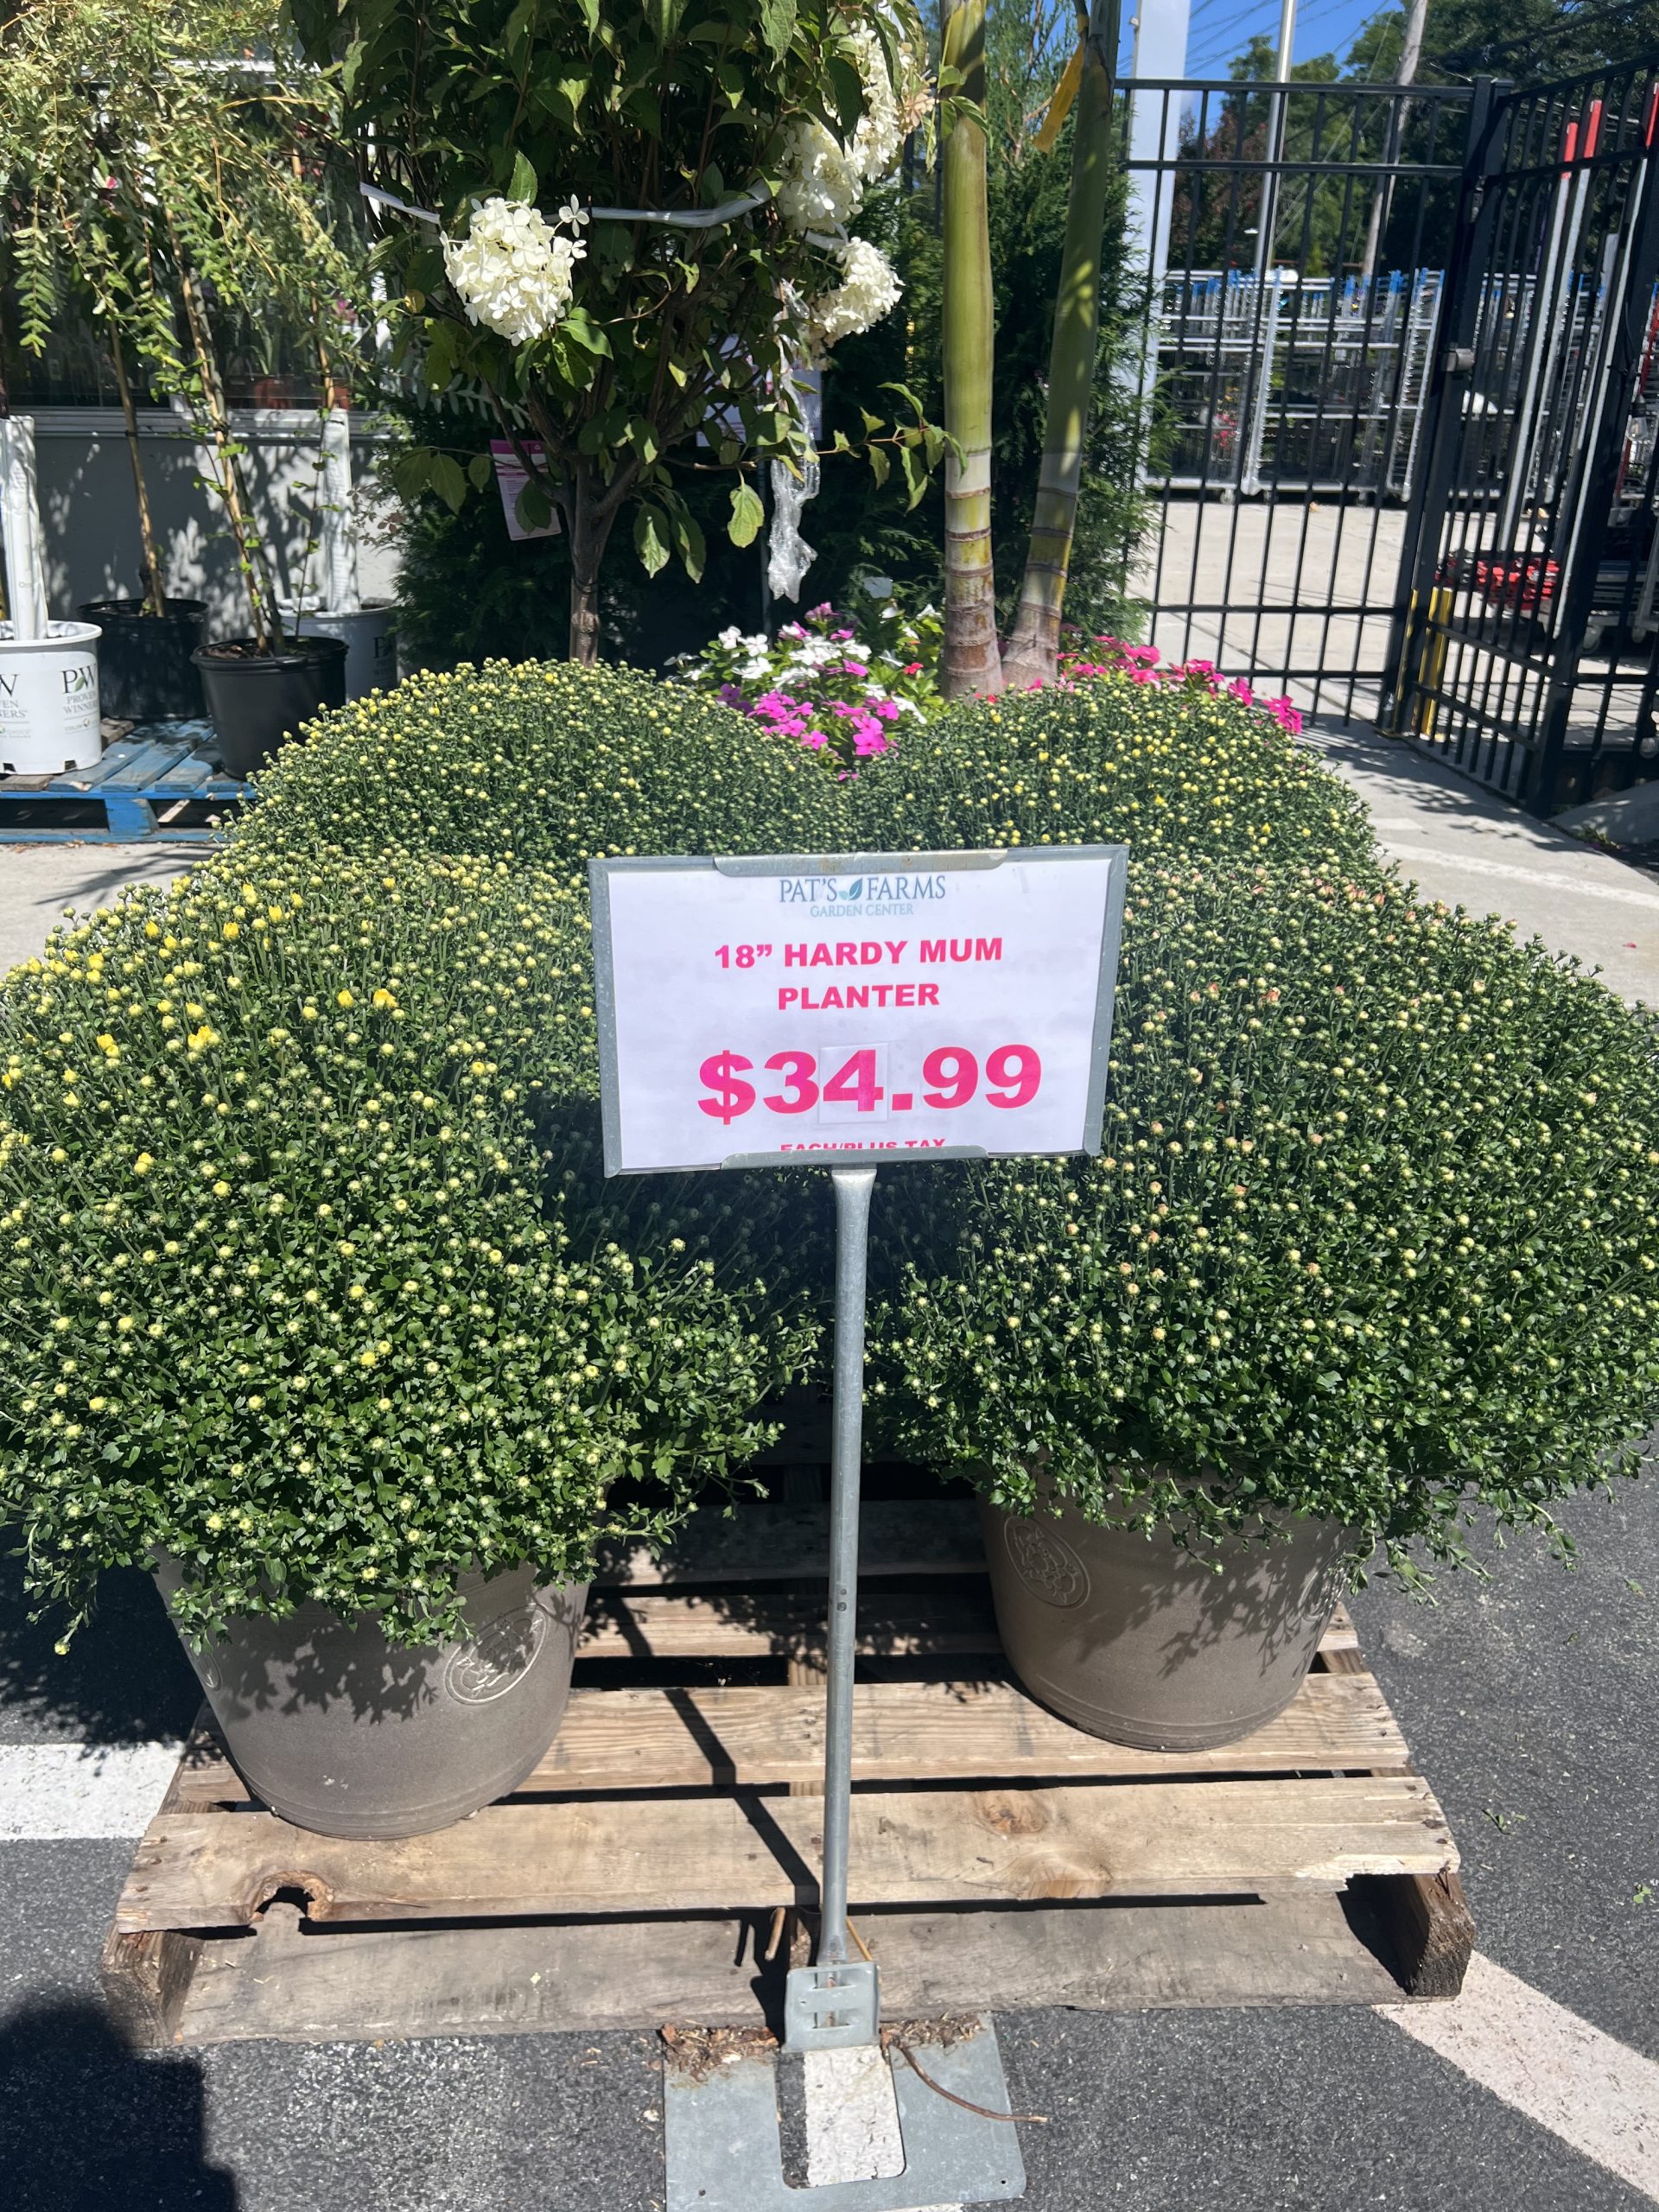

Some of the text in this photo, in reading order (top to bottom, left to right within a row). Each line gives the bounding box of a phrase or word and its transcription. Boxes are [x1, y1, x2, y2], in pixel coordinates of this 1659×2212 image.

[779, 875, 946, 903] PAT'S FARMS
[810, 903, 913, 918] GARDEN CENTER
[784, 940, 908, 967] HARDY
[920, 937, 1002, 963] MUM
[779, 983, 940, 1011] PLANTER
[697, 1044, 1042, 1126] $34.99
